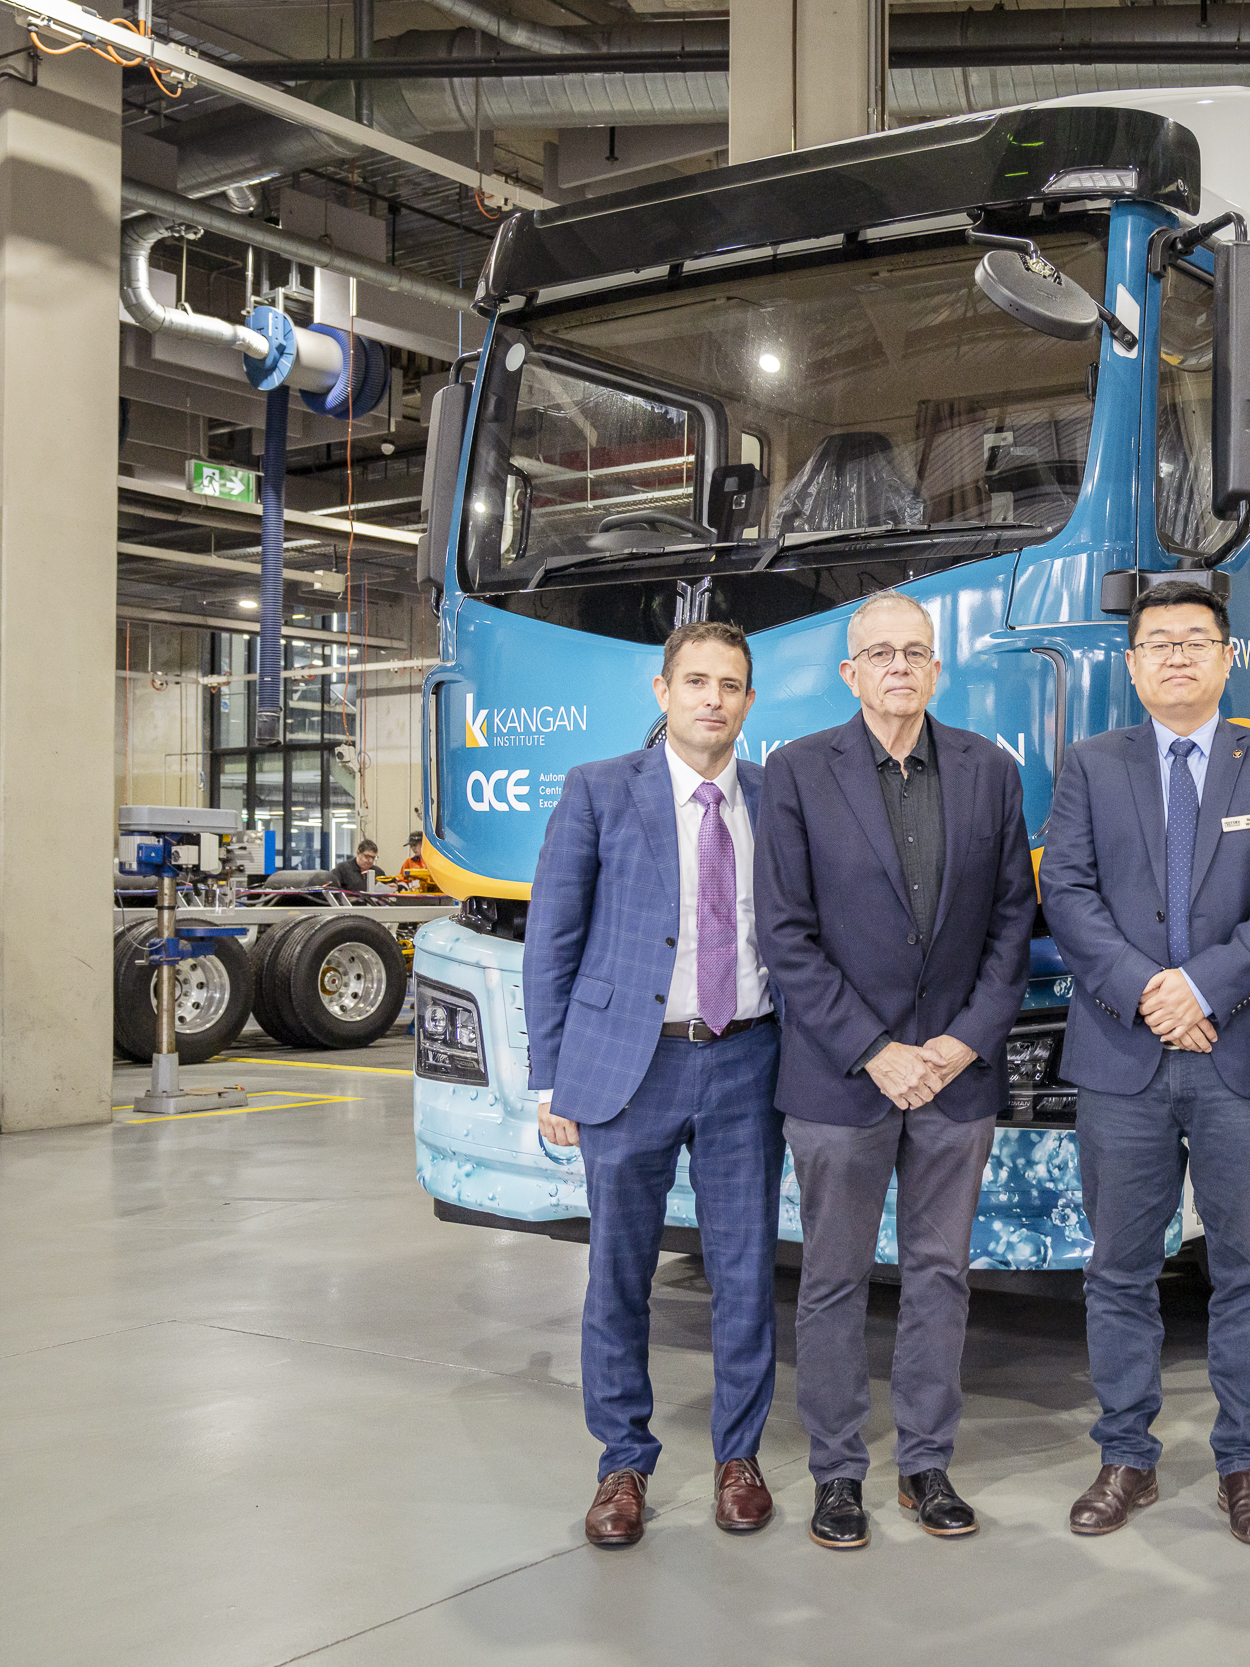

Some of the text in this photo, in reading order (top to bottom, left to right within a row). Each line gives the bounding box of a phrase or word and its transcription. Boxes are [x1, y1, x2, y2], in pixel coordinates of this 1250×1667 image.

[493, 705, 587, 733] KANGAN
[493, 735, 546, 747] INSTITUTE
[539, 772, 566, 782] Autom
[539, 785, 562, 795] Centr
[539, 798, 559, 808] Exce
